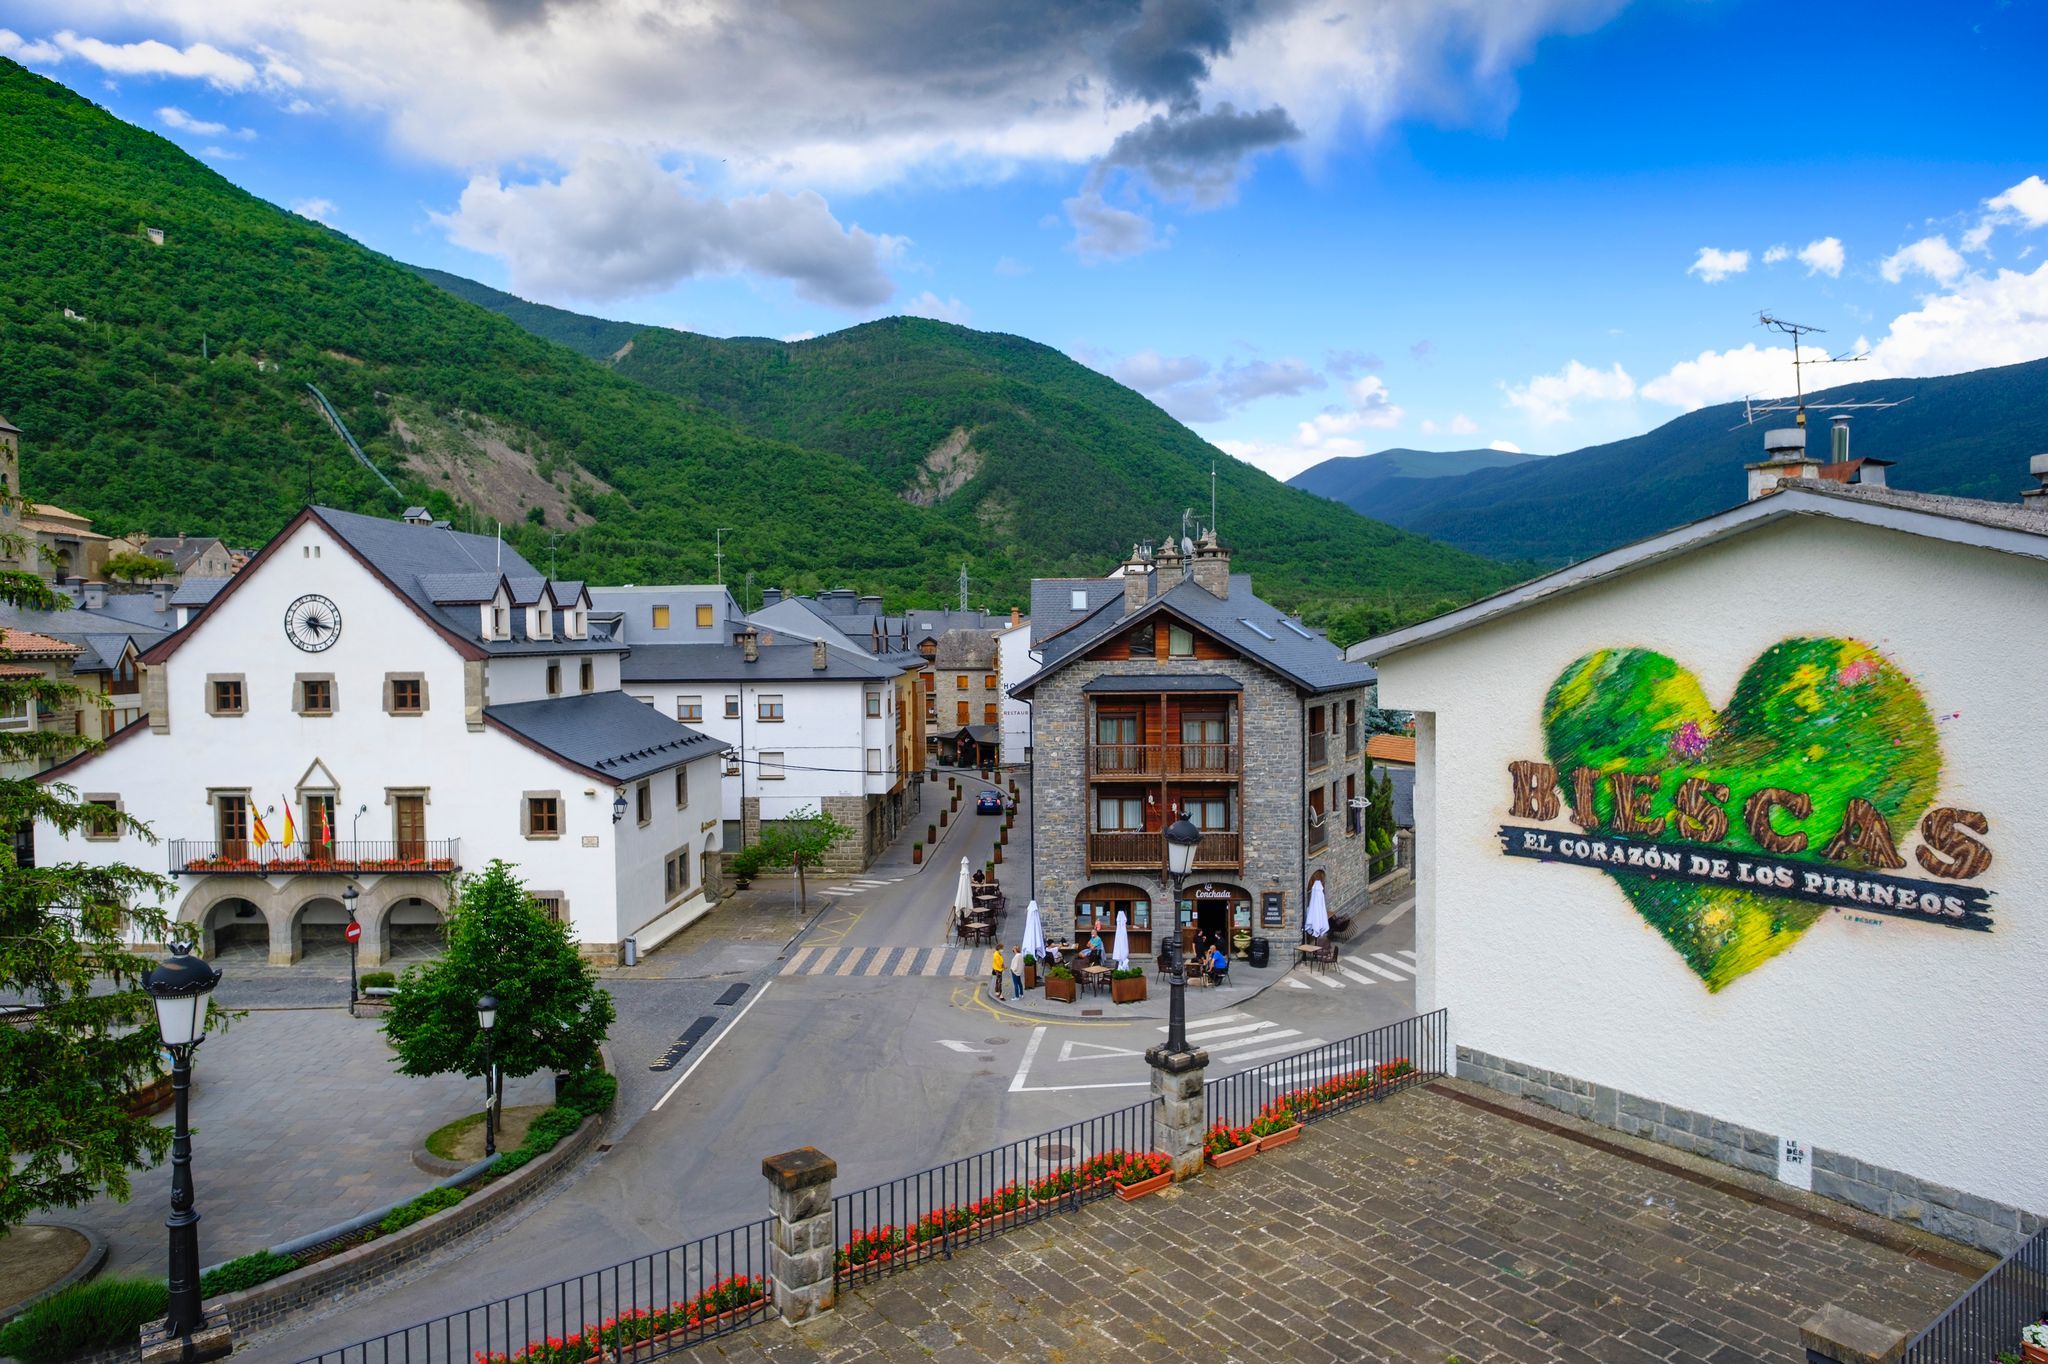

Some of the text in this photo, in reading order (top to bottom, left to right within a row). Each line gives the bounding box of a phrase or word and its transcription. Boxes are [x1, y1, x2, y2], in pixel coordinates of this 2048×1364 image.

[1508, 760, 1992, 879] BIESCAS
[1195, 889, 1231, 898] Conchada
[1523, 831, 1966, 918] EL CORAZÓN DE LOS PIRINEOS
